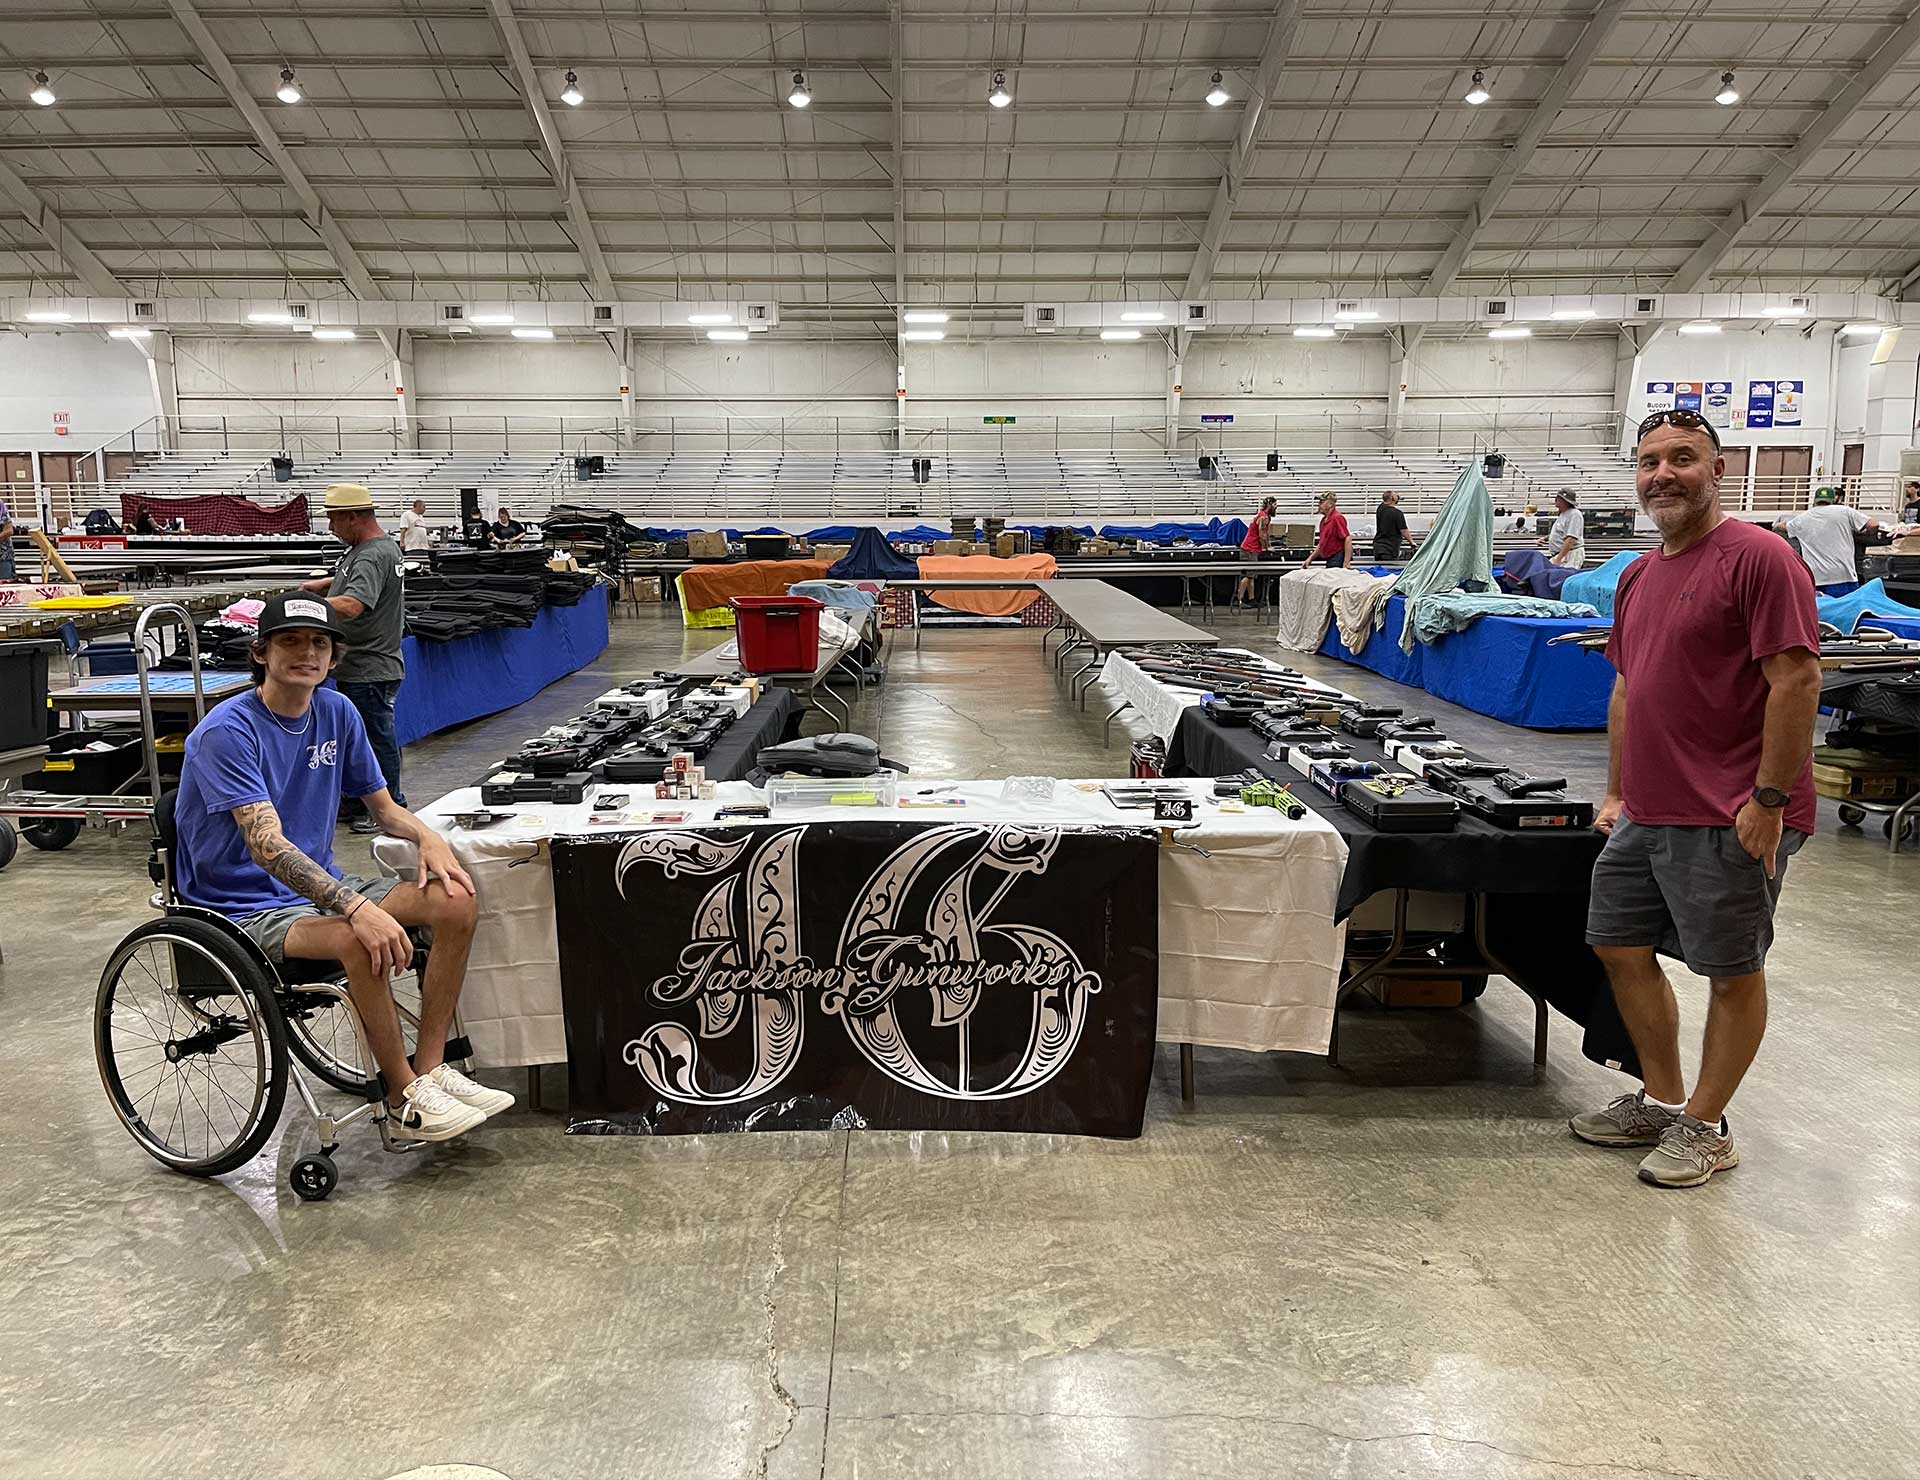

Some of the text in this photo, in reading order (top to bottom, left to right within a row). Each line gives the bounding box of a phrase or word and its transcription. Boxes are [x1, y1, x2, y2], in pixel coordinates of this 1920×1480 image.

[54, 413, 68, 422] EXIT
[1732, 410, 1746, 419] EXIT
[646, 935, 1076, 1016] Jackson Gunworks
